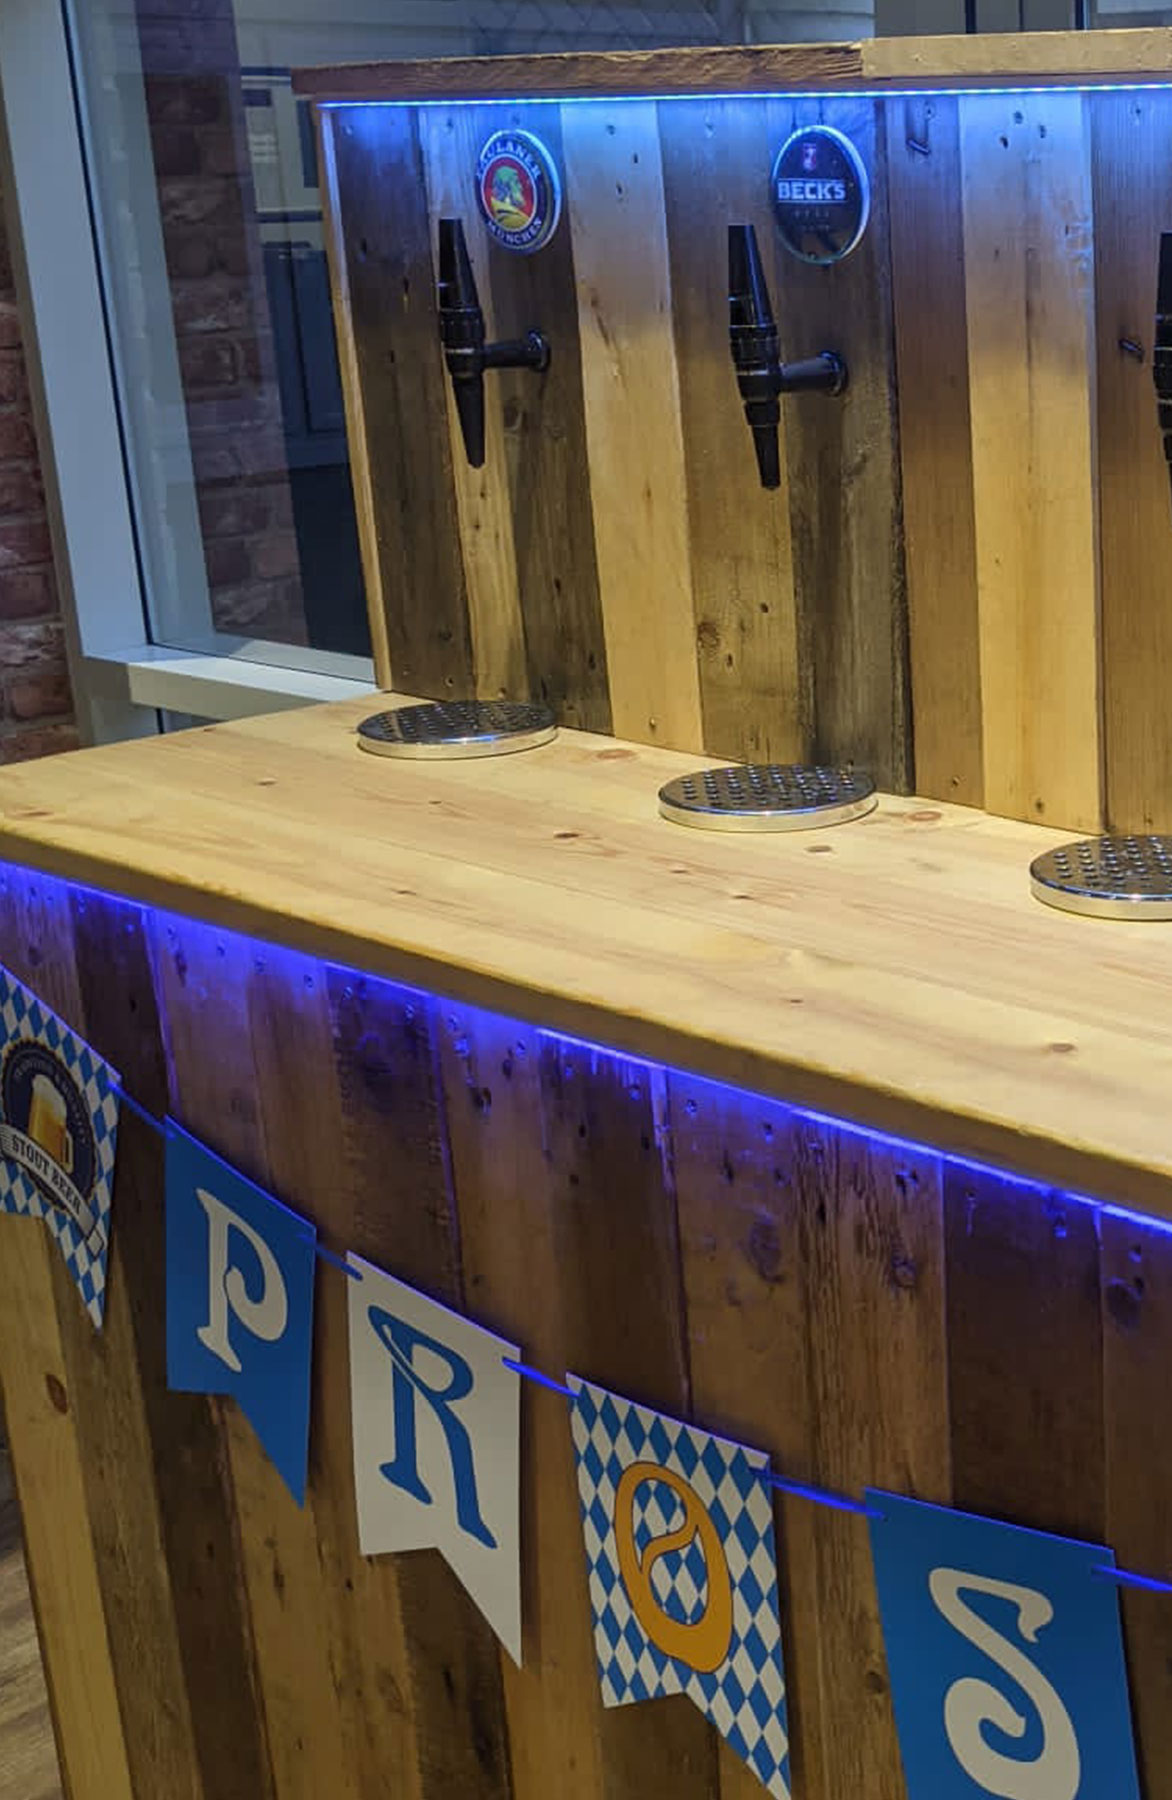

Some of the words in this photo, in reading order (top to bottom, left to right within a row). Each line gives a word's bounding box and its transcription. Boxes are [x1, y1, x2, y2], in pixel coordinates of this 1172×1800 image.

[777, 180, 846, 200] BECK'S
[12, 1135, 50, 1176] STOUT
[50, 1170, 82, 1215] BEER
